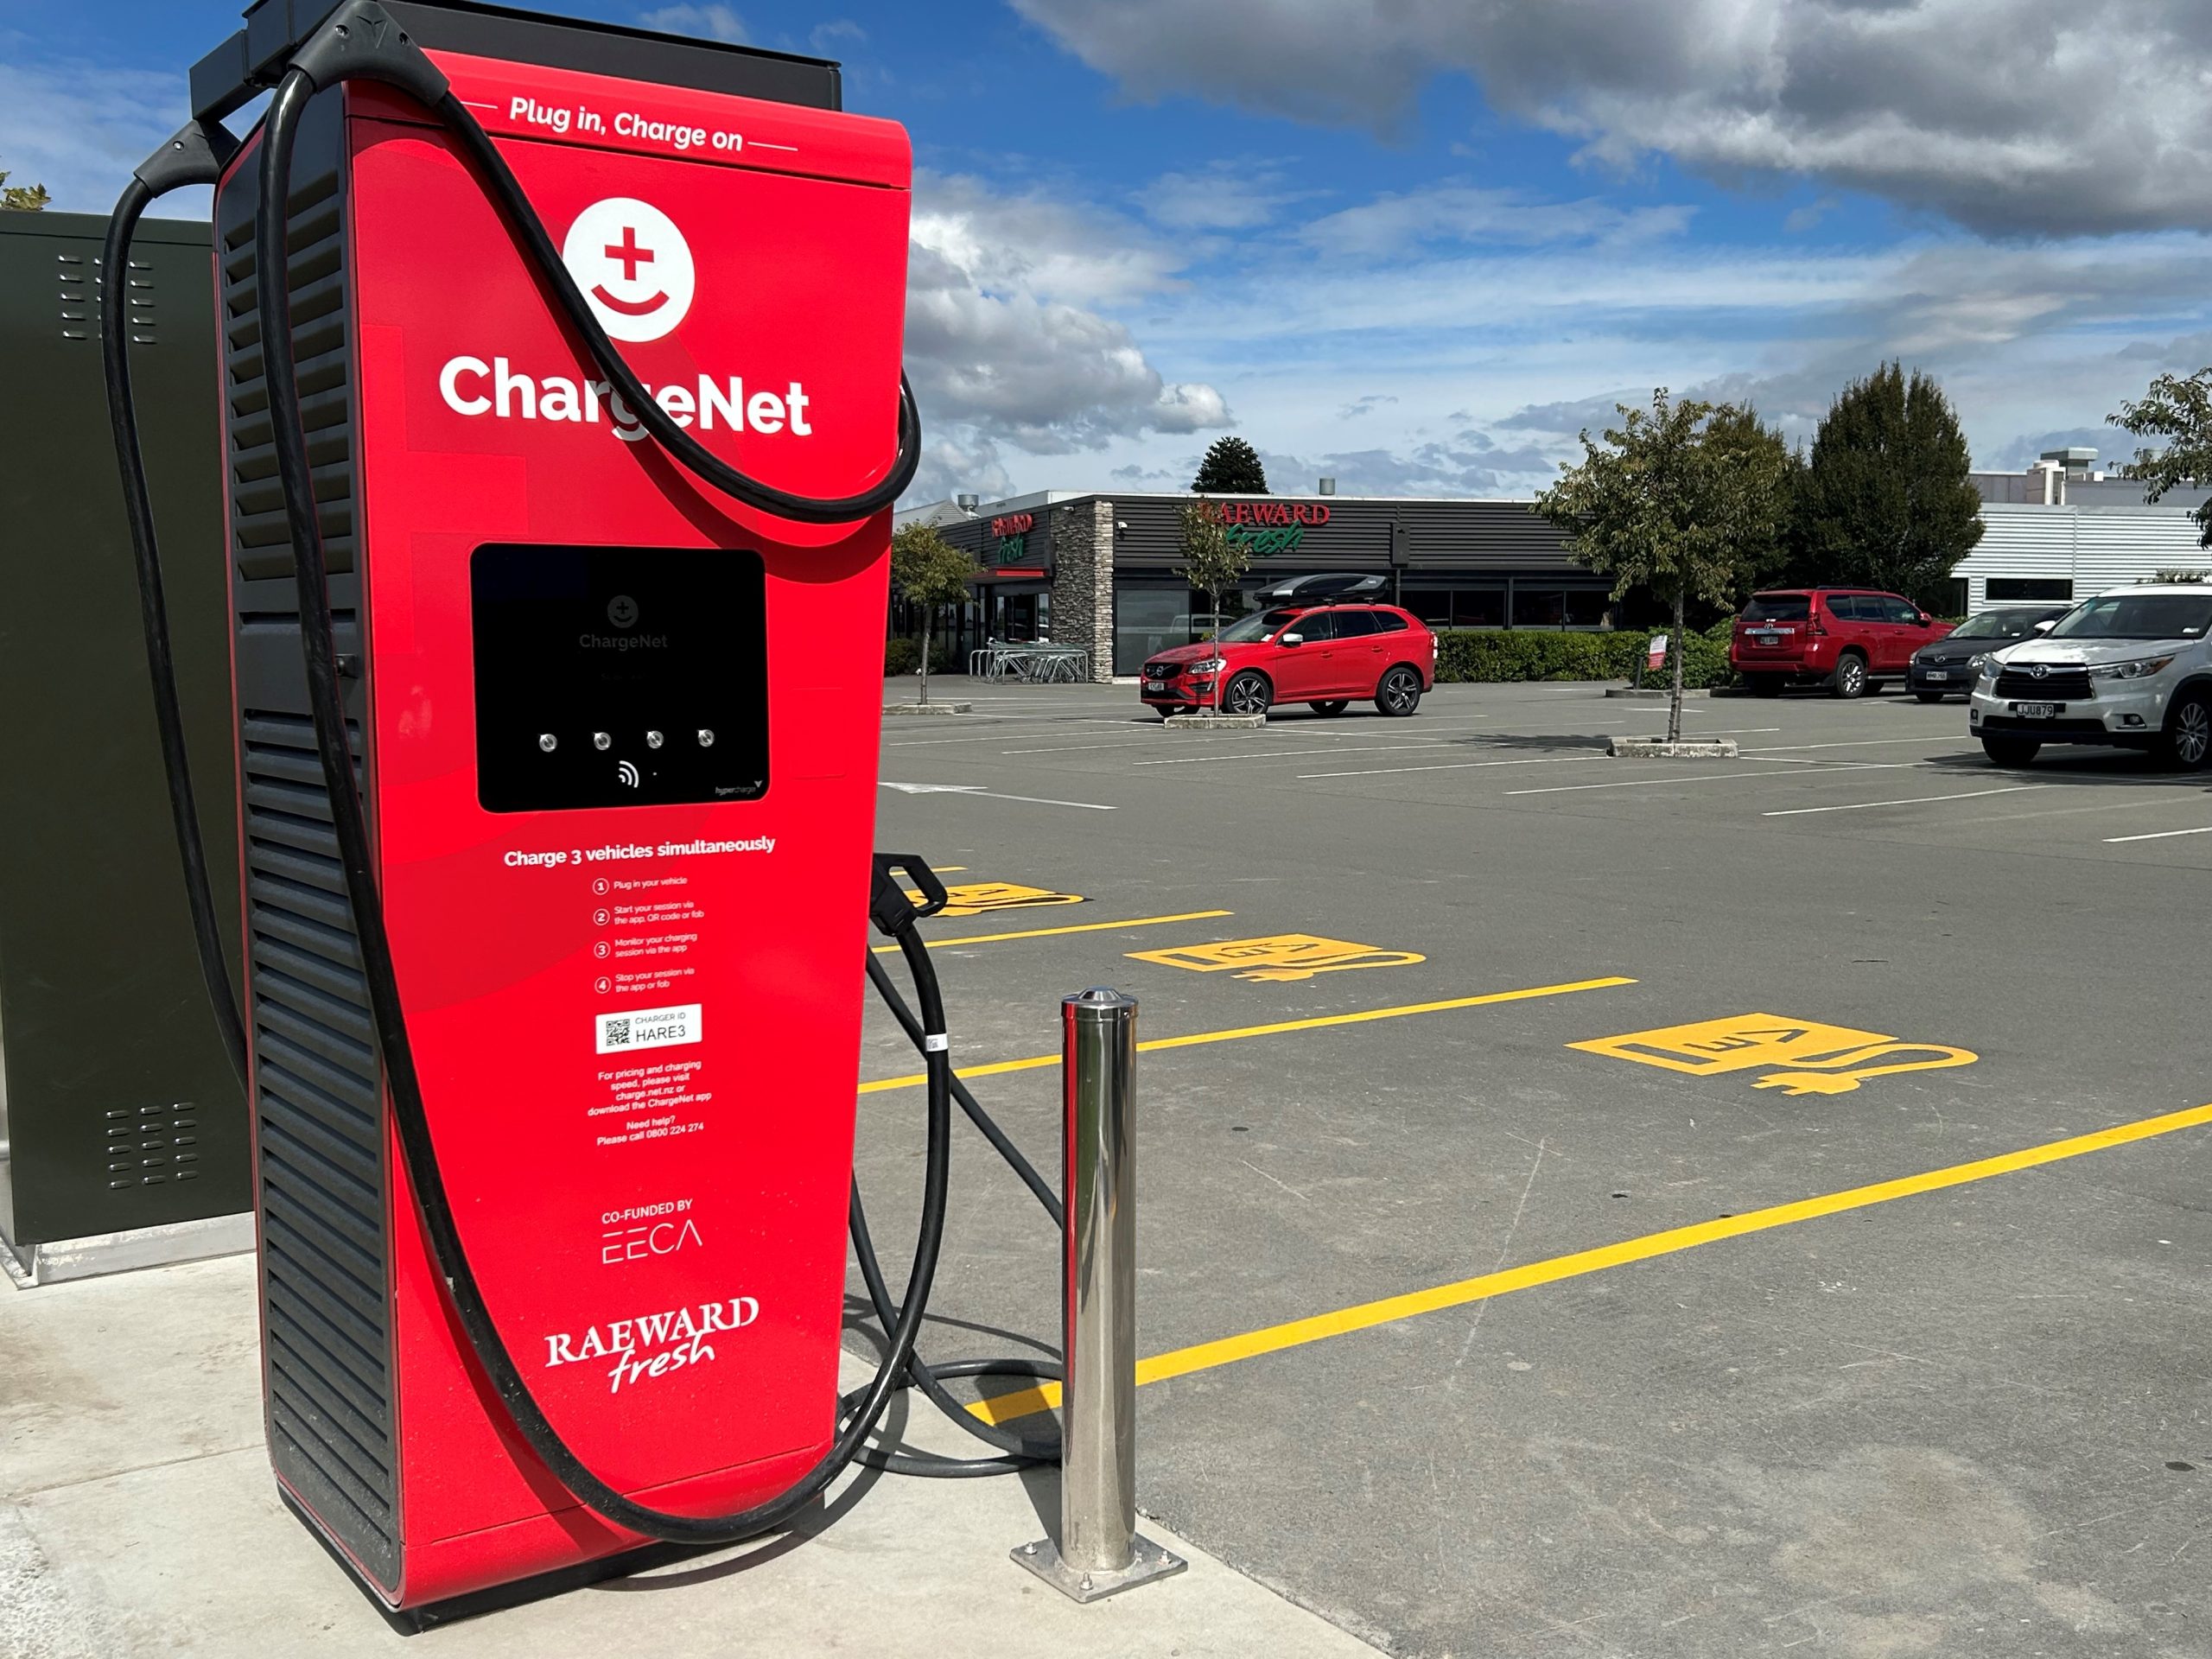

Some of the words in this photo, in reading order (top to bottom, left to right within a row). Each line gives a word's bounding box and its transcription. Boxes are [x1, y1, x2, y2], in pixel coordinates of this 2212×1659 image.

[510, 97, 571, 133] Plug
[577, 105, 607, 136] in,
[613, 112, 707, 149] Charge
[712, 130, 742, 151] on
[439, 355, 812, 441] ChargeNet
[579, 633, 668, 651] ChargeNet
[2018, 705, 2053, 715] JJU879
[504, 849, 567, 868] Charge
[570, 849, 582, 864] 3
[586, 843, 653, 861] vehicles
[657, 836, 776, 857] simultaneously
[613, 880, 632, 890] Plug
[642, 880, 659, 889] your
[661, 877, 688, 886] vehicle
[614, 906, 632, 914] Start
[634, 905, 652, 914] your
[653, 902, 682, 911] session
[647, 913, 659, 922] QR
[614, 938, 645, 946] Monitor
[646, 937, 664, 945] your
[664, 933, 698, 943] charging
[615, 949, 645, 957] session
[672, 944, 688, 953] app
[615, 974, 634, 982] Stop
[635, 972, 653, 982] your
[654, 969, 683, 978] session
[630, 983, 645, 992] app
[635, 1014, 675, 1025] CHARGER
[677, 1012, 686, 1020] ID
[636, 1025, 686, 1042] HARE3
[598, 1071, 614, 1081] For
[615, 1068, 645, 1080] pricing
[646, 1065, 664, 1075] and
[664, 1061, 702, 1072] charging
[642, 1076, 671, 1087] please
[672, 1072, 690, 1082] visit
[615, 1088, 675, 1101] charge.net.nz
[588, 1103, 630, 1116] download
[632, 1101, 646, 1109] the
[647, 1094, 694, 1109] ChargeNet
[695, 1092, 712, 1102] app
[626, 1120, 651, 1130] Need
[652, 1115, 676, 1127] help?
[596, 1135, 627, 1146] Please
[629, 1131, 645, 1141] call
[646, 1127, 668, 1138] 0800
[670, 1124, 686, 1135] 224
[688, 1122, 704, 1133] 274
[601, 1204, 675, 1224] CO-FUNDED
[677, 1198, 693, 1211] BY
[544, 1296, 760, 1368] RAEWARD
[607, 1330, 715, 1394] fresh
